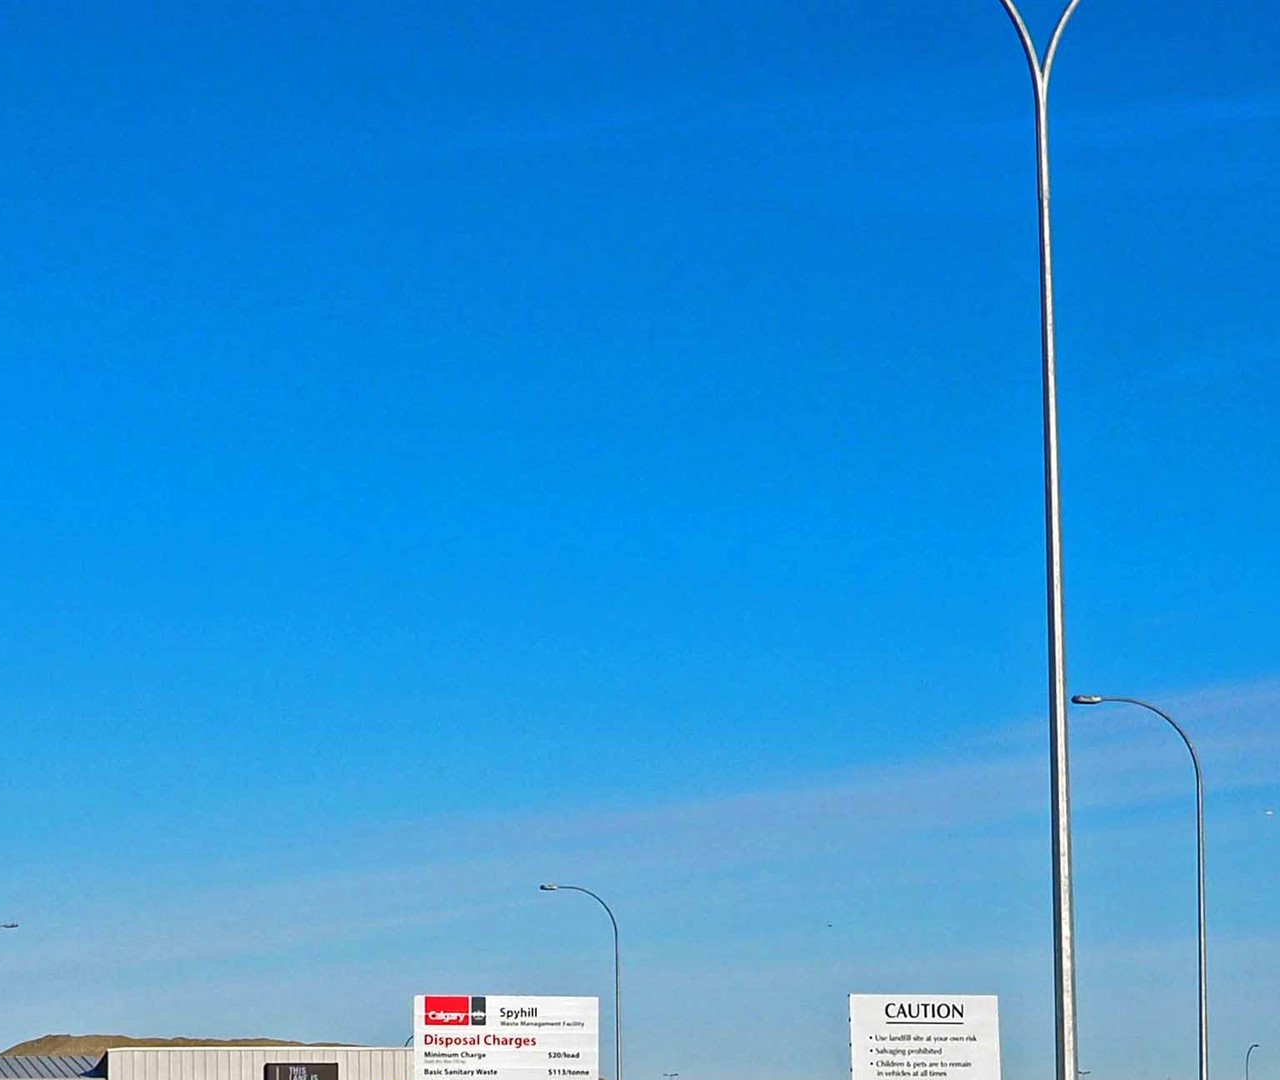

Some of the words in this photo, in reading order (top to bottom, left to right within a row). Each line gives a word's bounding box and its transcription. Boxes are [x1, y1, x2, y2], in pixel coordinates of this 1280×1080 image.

[428, 1010, 465, 1022] Calgary
[500, 1008, 537, 1020] Spyhill
[885, 1003, 964, 1019] CAUTION
[424, 1034, 480, 1048] Disposal
[484, 1034, 536, 1048] Charges
[461, 1052, 486, 1060] Charge
